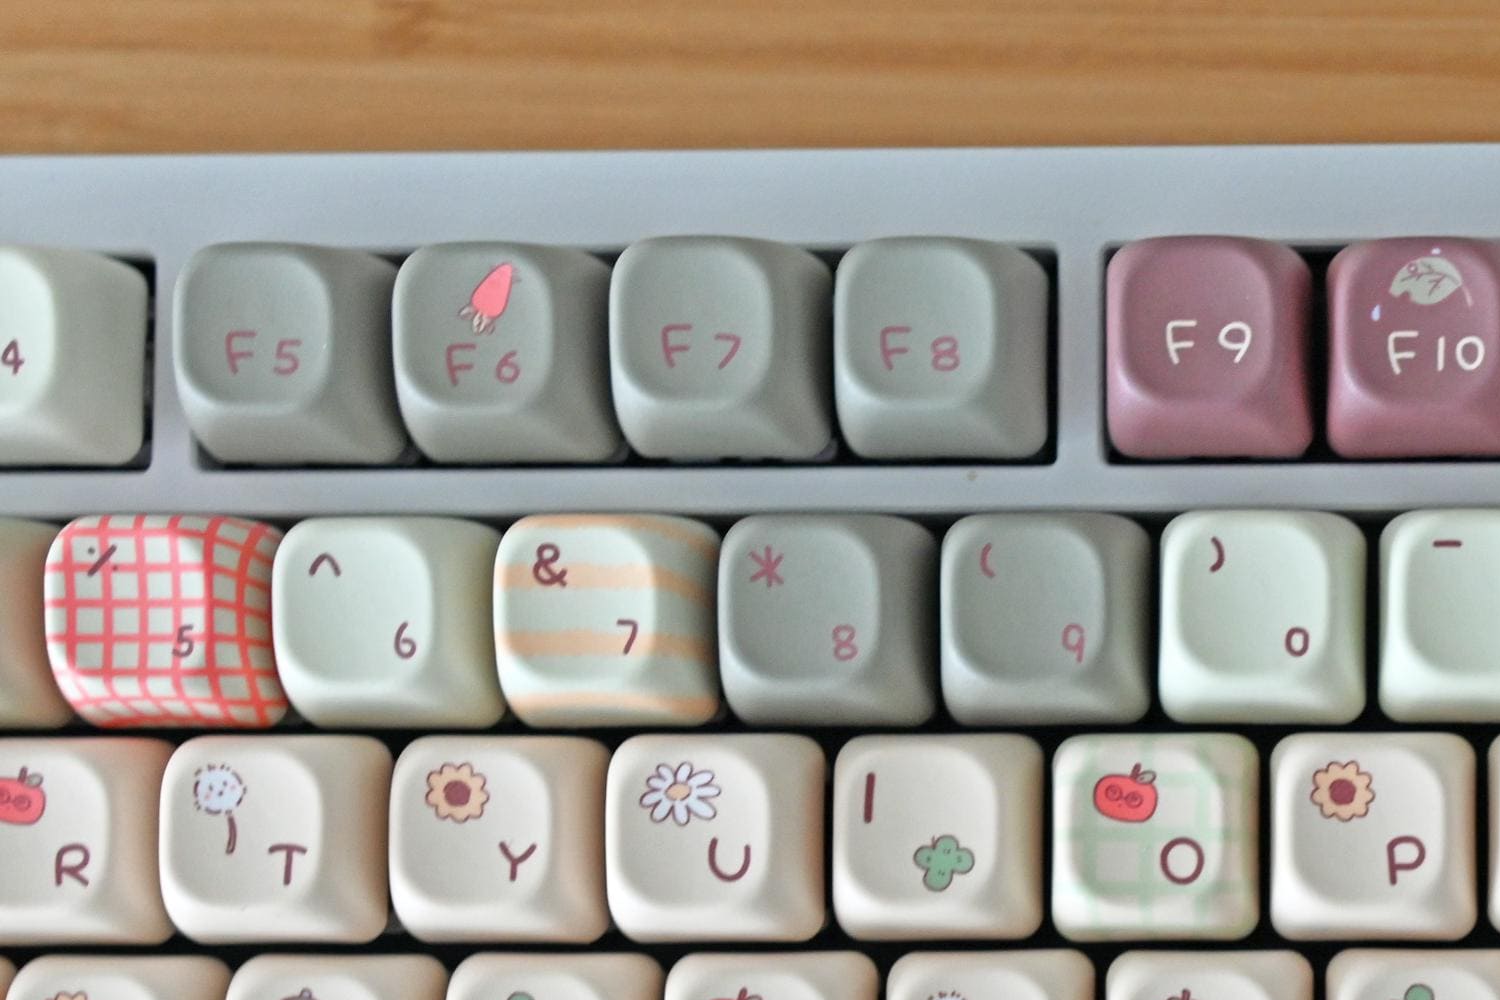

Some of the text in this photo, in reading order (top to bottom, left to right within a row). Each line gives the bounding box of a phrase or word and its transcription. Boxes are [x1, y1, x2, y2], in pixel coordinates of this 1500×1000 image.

[1, 340, 24, 374] 4
[225, 330, 302, 376] F5
[662, 324, 741, 370] F7
[880, 326, 960, 372] F8
[1166, 320, 1251, 364] F9
[1388, 331, 1485, 374] F10
[446, 343, 520, 387] F6
[86, 543, 119, 577] %
[533, 544, 567, 587] &
[980, 543, 995, 578] (
[1210, 537, 1225, 572] )
[170, 623, 196, 660] 5
[394, 622, 416, 659] 6
[617, 619, 638, 654] 7
[830, 623, 859, 661] 8
[1061, 623, 1086, 664] 9
[1285, 627, 1309, 657] 0
[863, 771, 876, 825] I
[55, 843, 89, 886] R
[268, 844, 307, 886] T
[499, 842, 536, 881] Y
[708, 837, 751, 882] U
[1160, 837, 1204, 885] O
[1387, 836, 1425, 885] P
